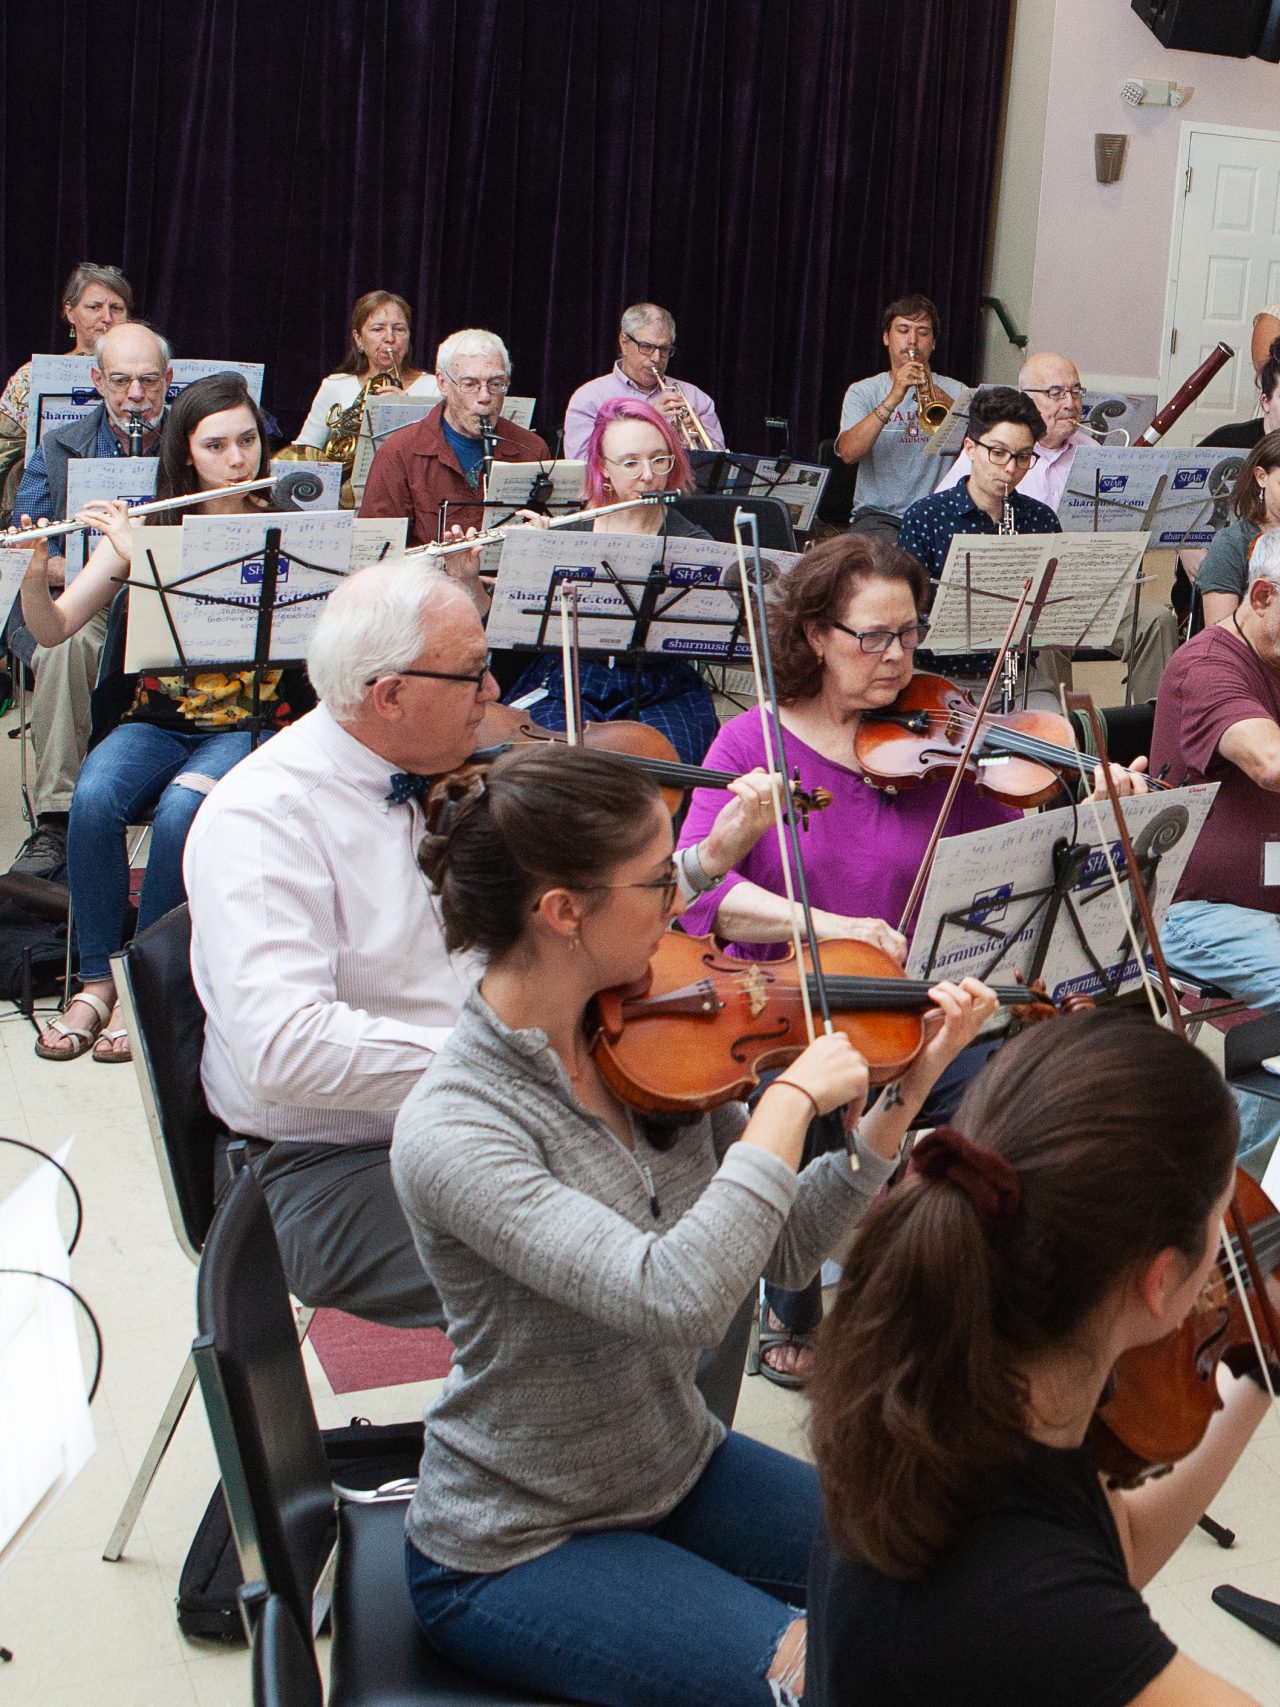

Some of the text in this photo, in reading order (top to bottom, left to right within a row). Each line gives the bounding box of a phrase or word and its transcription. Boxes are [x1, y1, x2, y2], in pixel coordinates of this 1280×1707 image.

[1103, 479, 1123, 488] SHAR
[1178, 474, 1203, 483] SHAR
[248, 565, 282, 576] SHR
[920, 928, 1034, 974] sarmusic.cm
